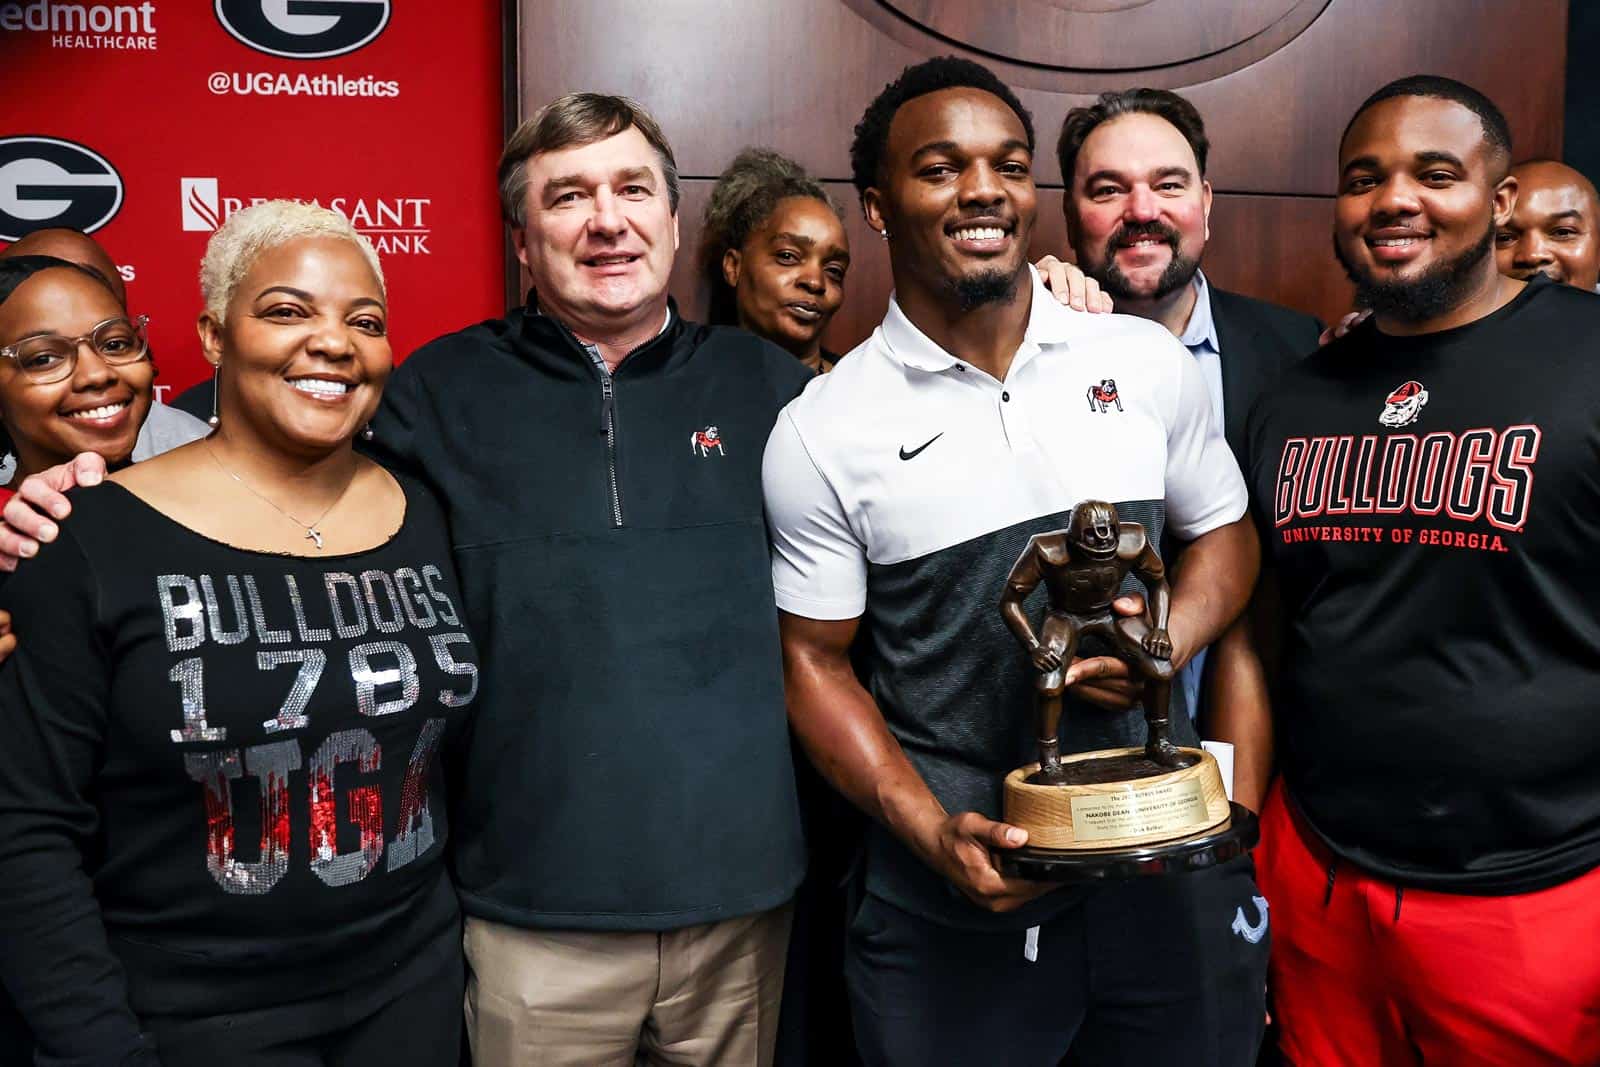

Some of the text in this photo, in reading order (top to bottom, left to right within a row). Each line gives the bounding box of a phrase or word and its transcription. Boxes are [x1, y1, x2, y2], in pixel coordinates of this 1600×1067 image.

[52, 35, 157, 49] HEALTHCARE
[208, 71, 400, 97] @UGAAthletics
[1275, 424, 1542, 532] BULLDOGS
[1283, 527, 1385, 544] UNIVERSITY
[1391, 529, 1413, 543] OF
[157, 565, 461, 652] BULLDOGS
[169, 632, 478, 743] 1785
